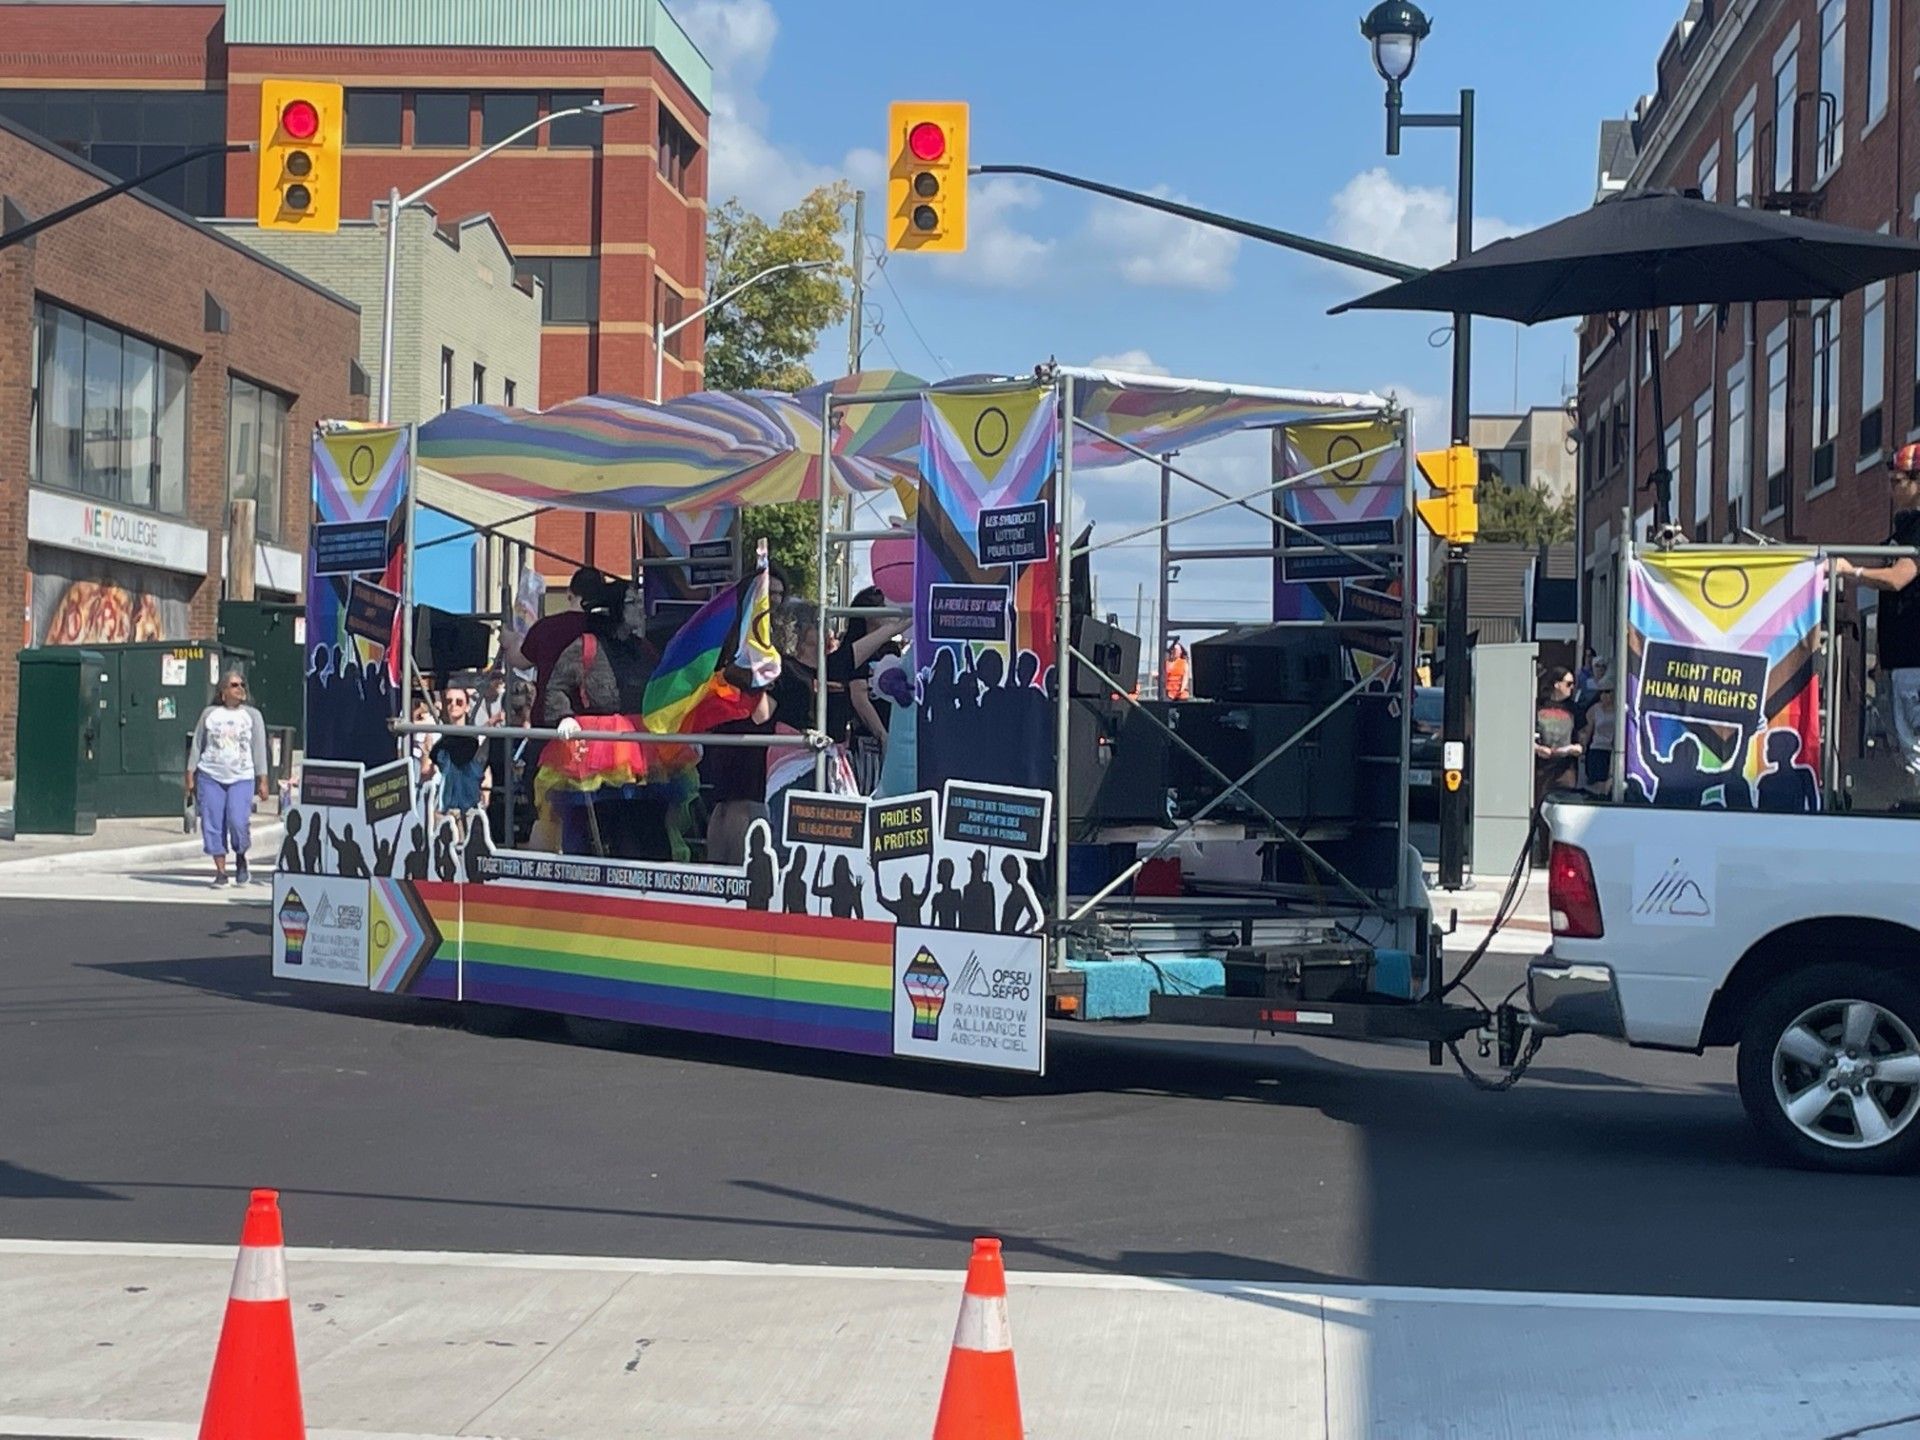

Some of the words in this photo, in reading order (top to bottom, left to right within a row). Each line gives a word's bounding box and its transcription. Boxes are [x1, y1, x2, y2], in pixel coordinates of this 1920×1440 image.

[1667, 661, 1709, 681] FIGHT
[1712, 666, 1742, 686] FOR
[1645, 679, 1700, 703] HUMAN
[1703, 689, 1758, 710] RIGHTS
[880, 809, 910, 829] PRIDE
[911, 806, 923, 824] IS
[874, 836, 882, 852] A
[883, 828, 929, 851] PROTEST
[476, 856, 520, 876] TOGETHER
[520, 860, 534, 877] WE
[535, 862, 554, 879] ARE
[606, 868, 653, 888] ENSEMBLE
[654, 871, 682, 890] NOUS
[682, 874, 725, 895] SOMMES
[725, 878, 752, 897] FORT
[992, 968, 1032, 986] OPSEU
[991, 983, 1030, 1002] SEFPO
[953, 1002, 1028, 1022] RAINBOW
[952, 1017, 1027, 1038] ALLIANCE
